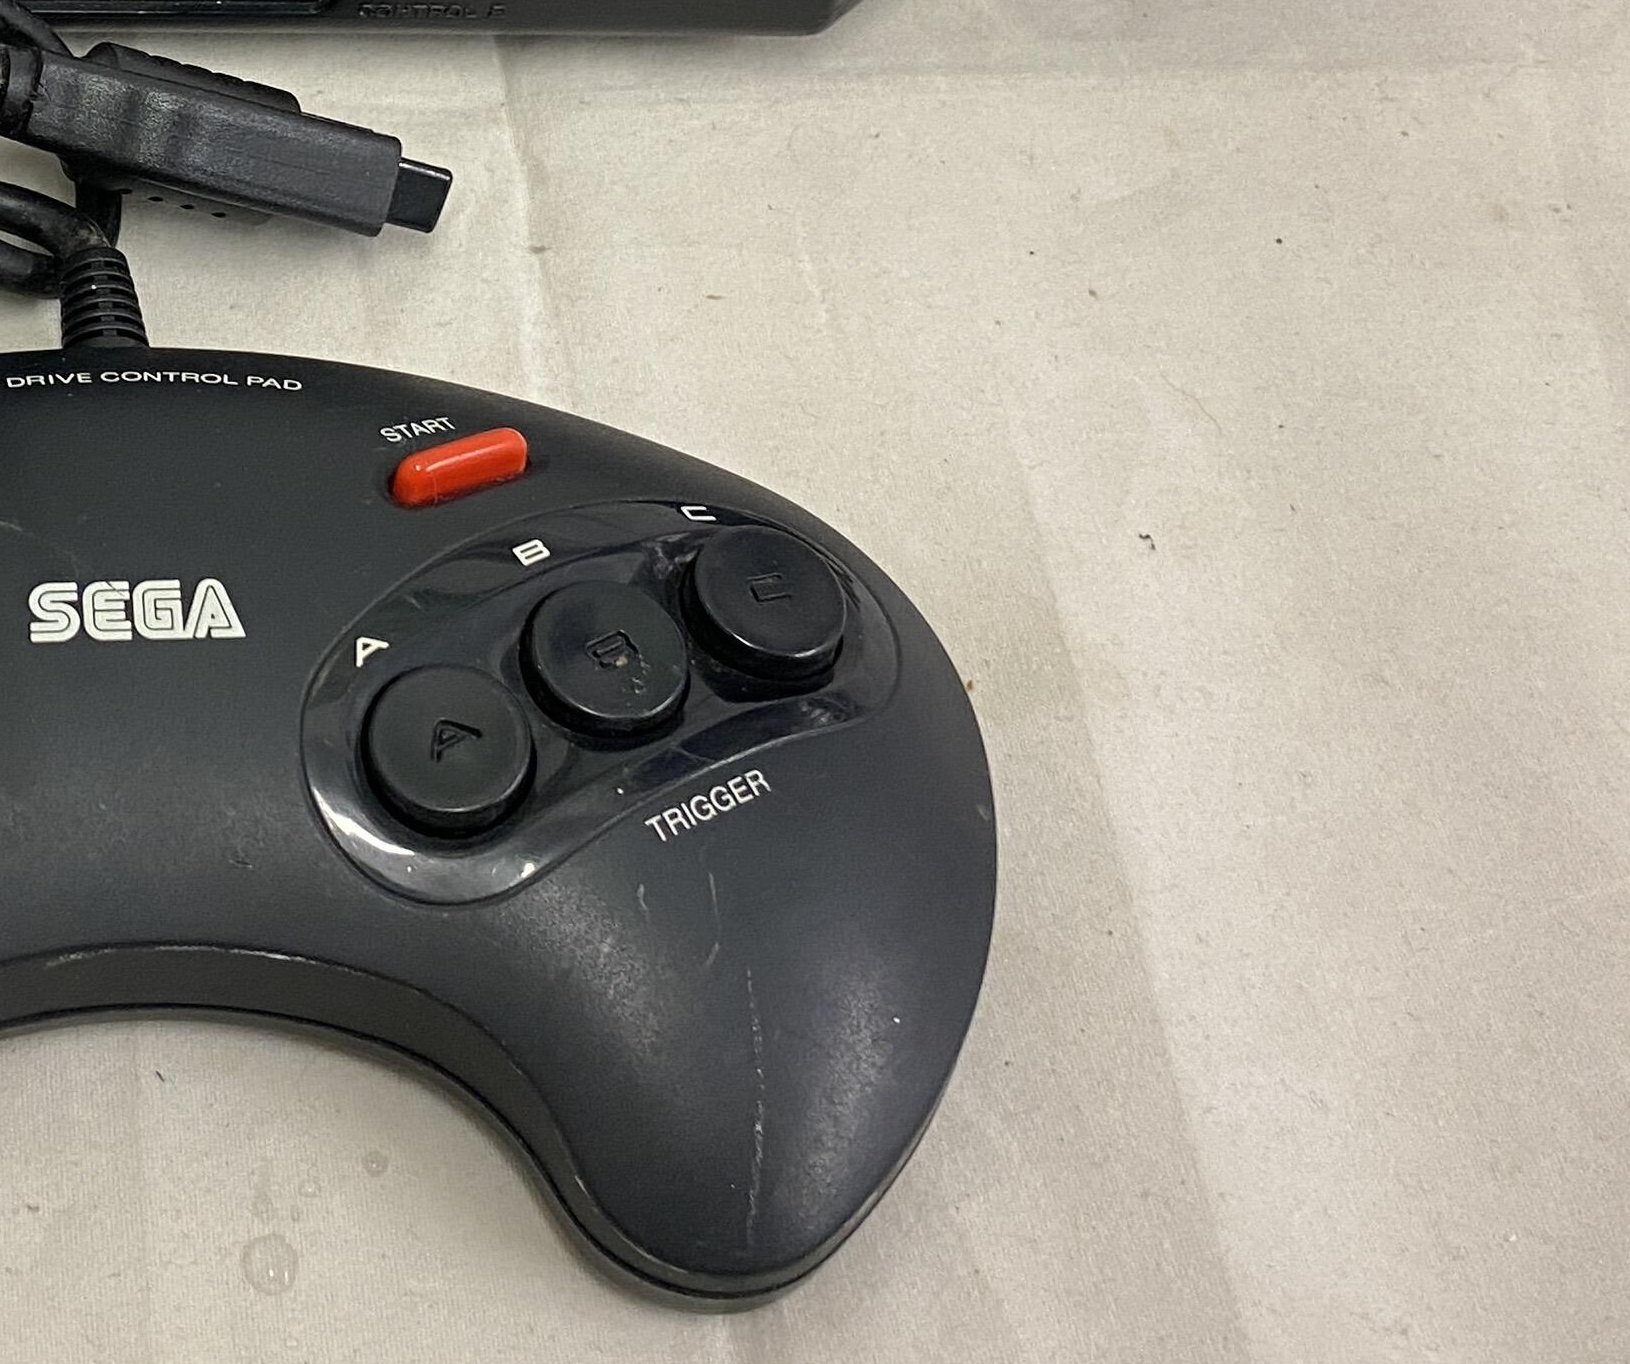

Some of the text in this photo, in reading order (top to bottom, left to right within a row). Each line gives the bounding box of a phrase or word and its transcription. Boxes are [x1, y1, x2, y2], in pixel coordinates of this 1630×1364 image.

[6, 372, 92, 388] DRIVE
[100, 371, 238, 386] CONTROL
[247, 376, 302, 391] PAD
[380, 416, 456, 443] START
[680, 505, 716, 522] C
[512, 539, 550, 566] B
[28, 578, 246, 643] SEGA
[356, 637, 389, 667] A
[645, 769, 771, 842] TRIGGER
